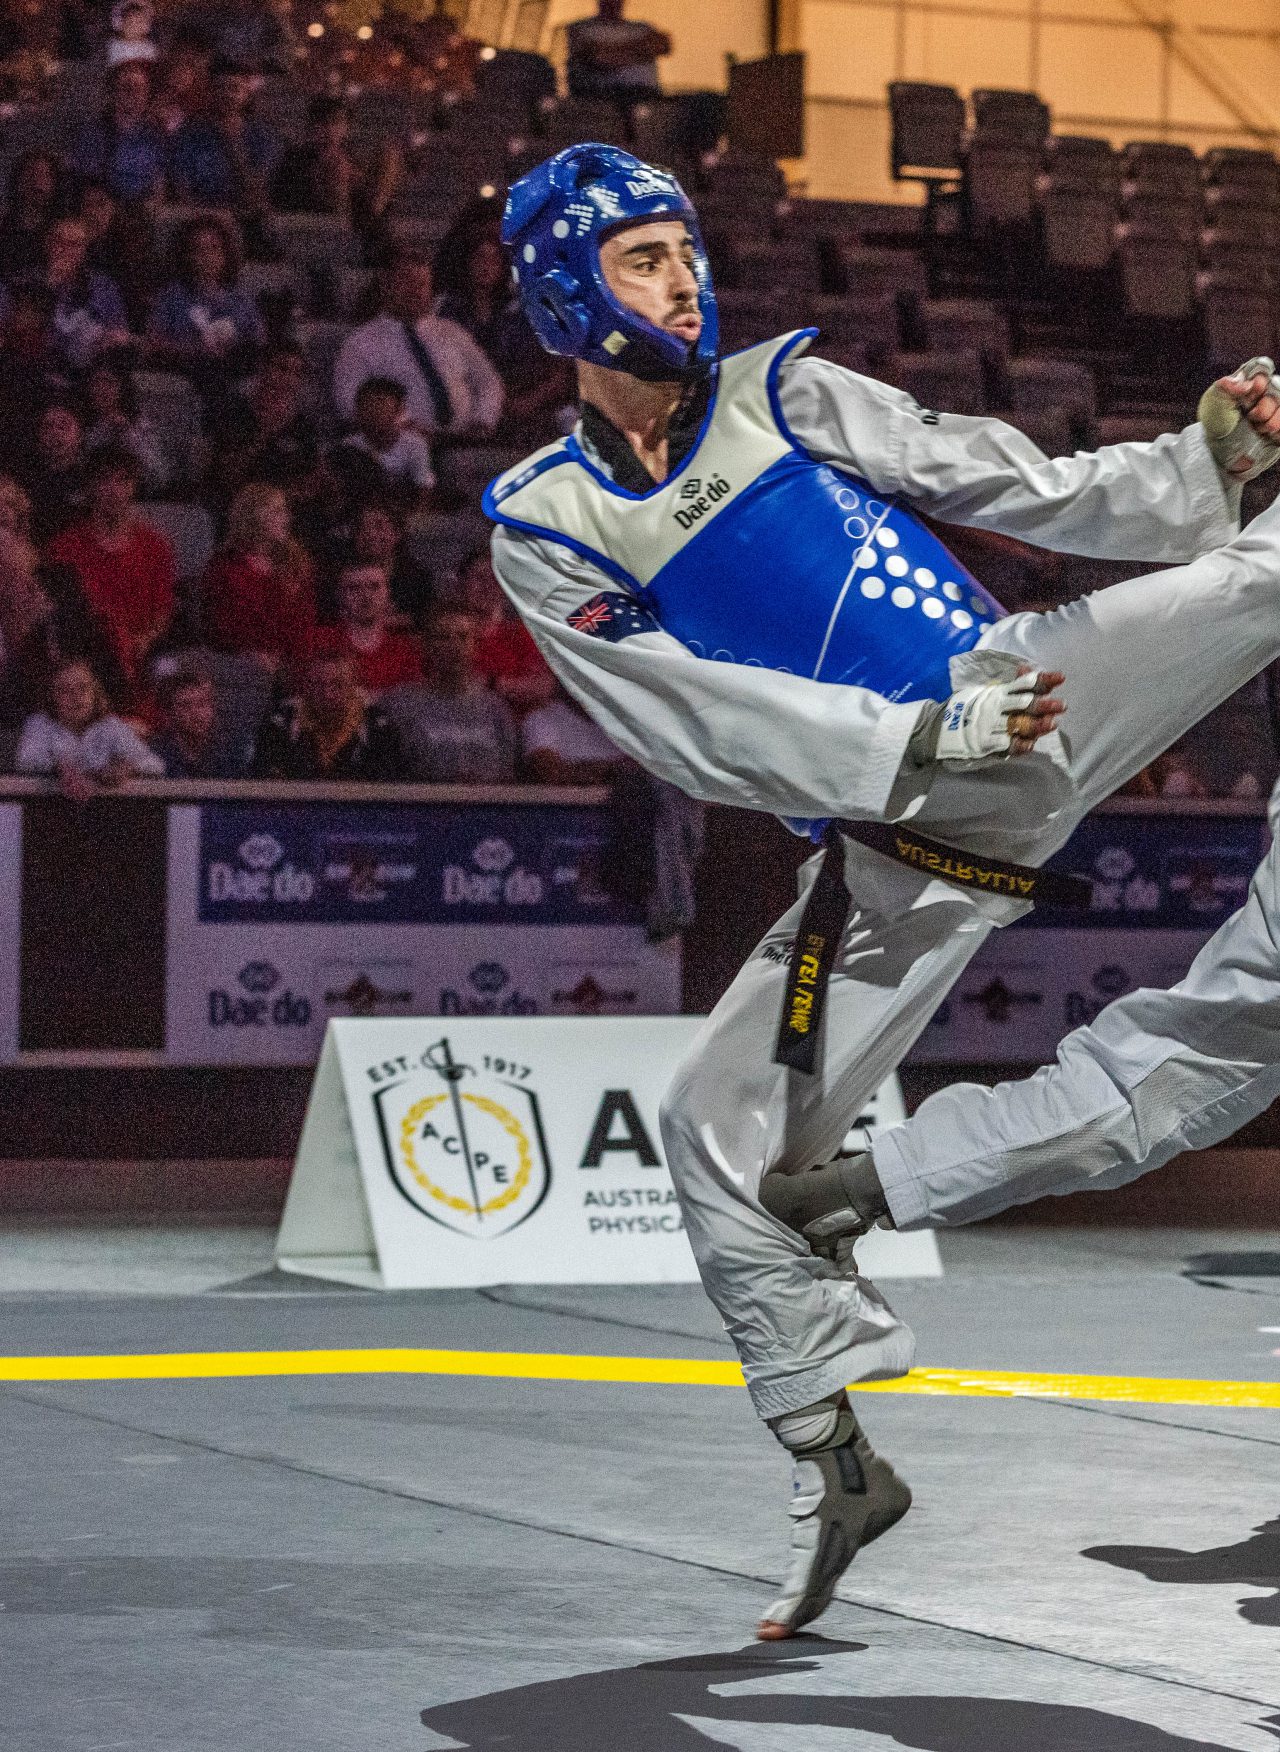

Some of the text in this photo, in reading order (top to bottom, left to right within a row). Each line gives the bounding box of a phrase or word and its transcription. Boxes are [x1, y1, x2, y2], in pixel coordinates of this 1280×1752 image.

[673, 478, 731, 530] Daedo
[208, 862, 315, 901] Daedo
[442, 865, 544, 904] Daedo
[208, 987, 311, 1027] Daedo
[366, 1055, 532, 1083] EST. 1917
